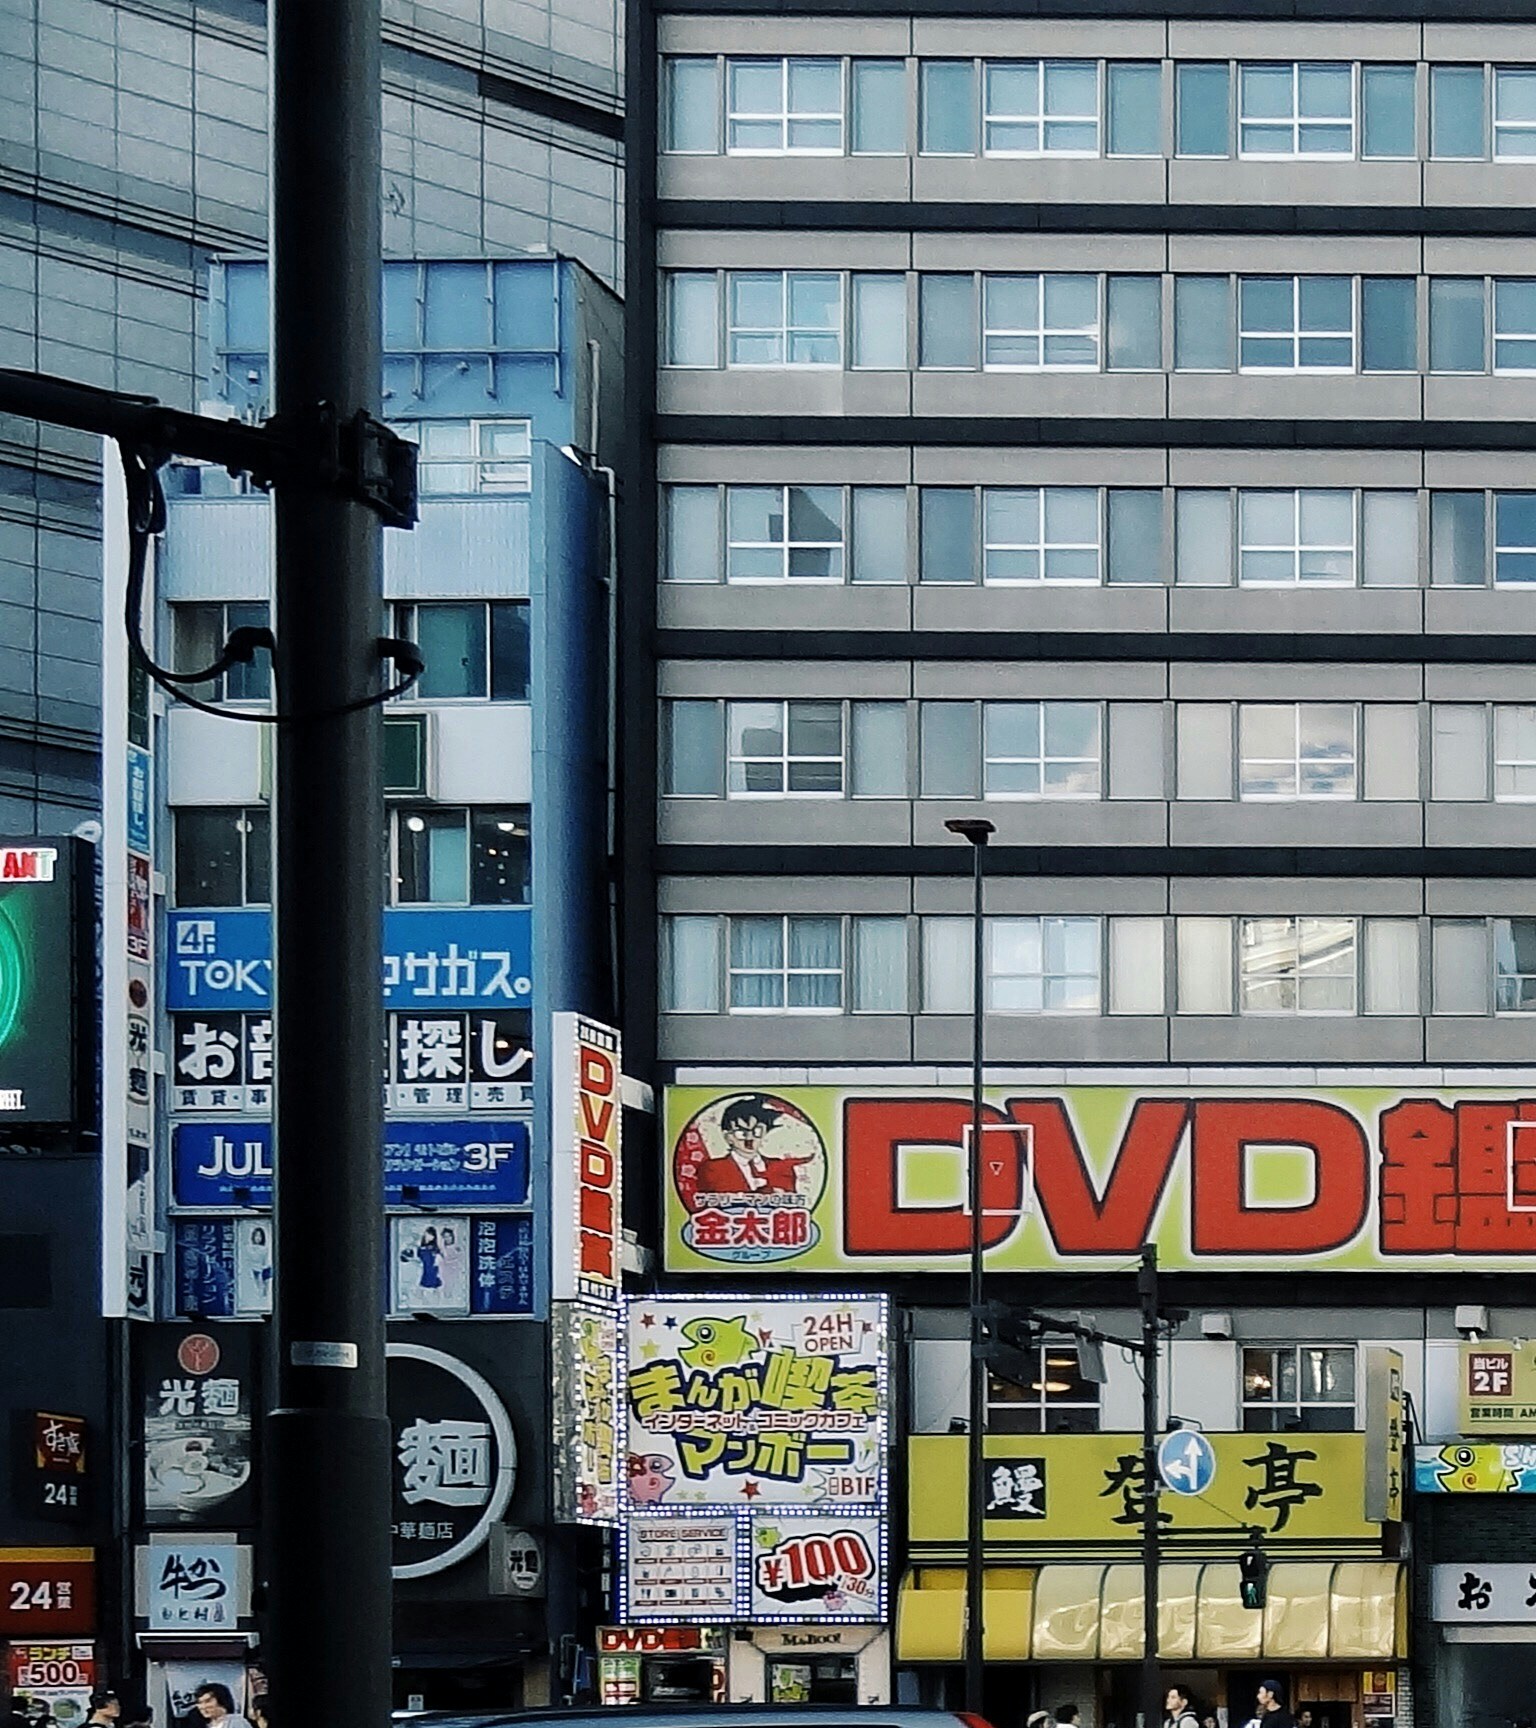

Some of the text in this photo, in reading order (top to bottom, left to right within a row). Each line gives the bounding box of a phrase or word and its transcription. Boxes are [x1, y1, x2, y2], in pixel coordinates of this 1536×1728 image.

[180, 961, 272, 997] TOK
[198, 1136, 272, 1176] JUL
[463, 1143, 514, 1171] 3F
[693, 1209, 808, 1246] 金太郎
[803, 1313, 853, 1337] 24H
[804, 1336, 854, 1352] OPEN
[629, 1349, 879, 1414] まんが喫茶
[1471, 1357, 1510, 1371] 当ビル
[1473, 1371, 1509, 1393] 2F
[680, 1432, 851, 1480] マンボー
[44, 1482, 67, 1505] 24
[159, 1554, 228, 1601] 牛かつ
[762, 1534, 868, 1590] ¥100
[9, 1581, 53, 1611] 24
